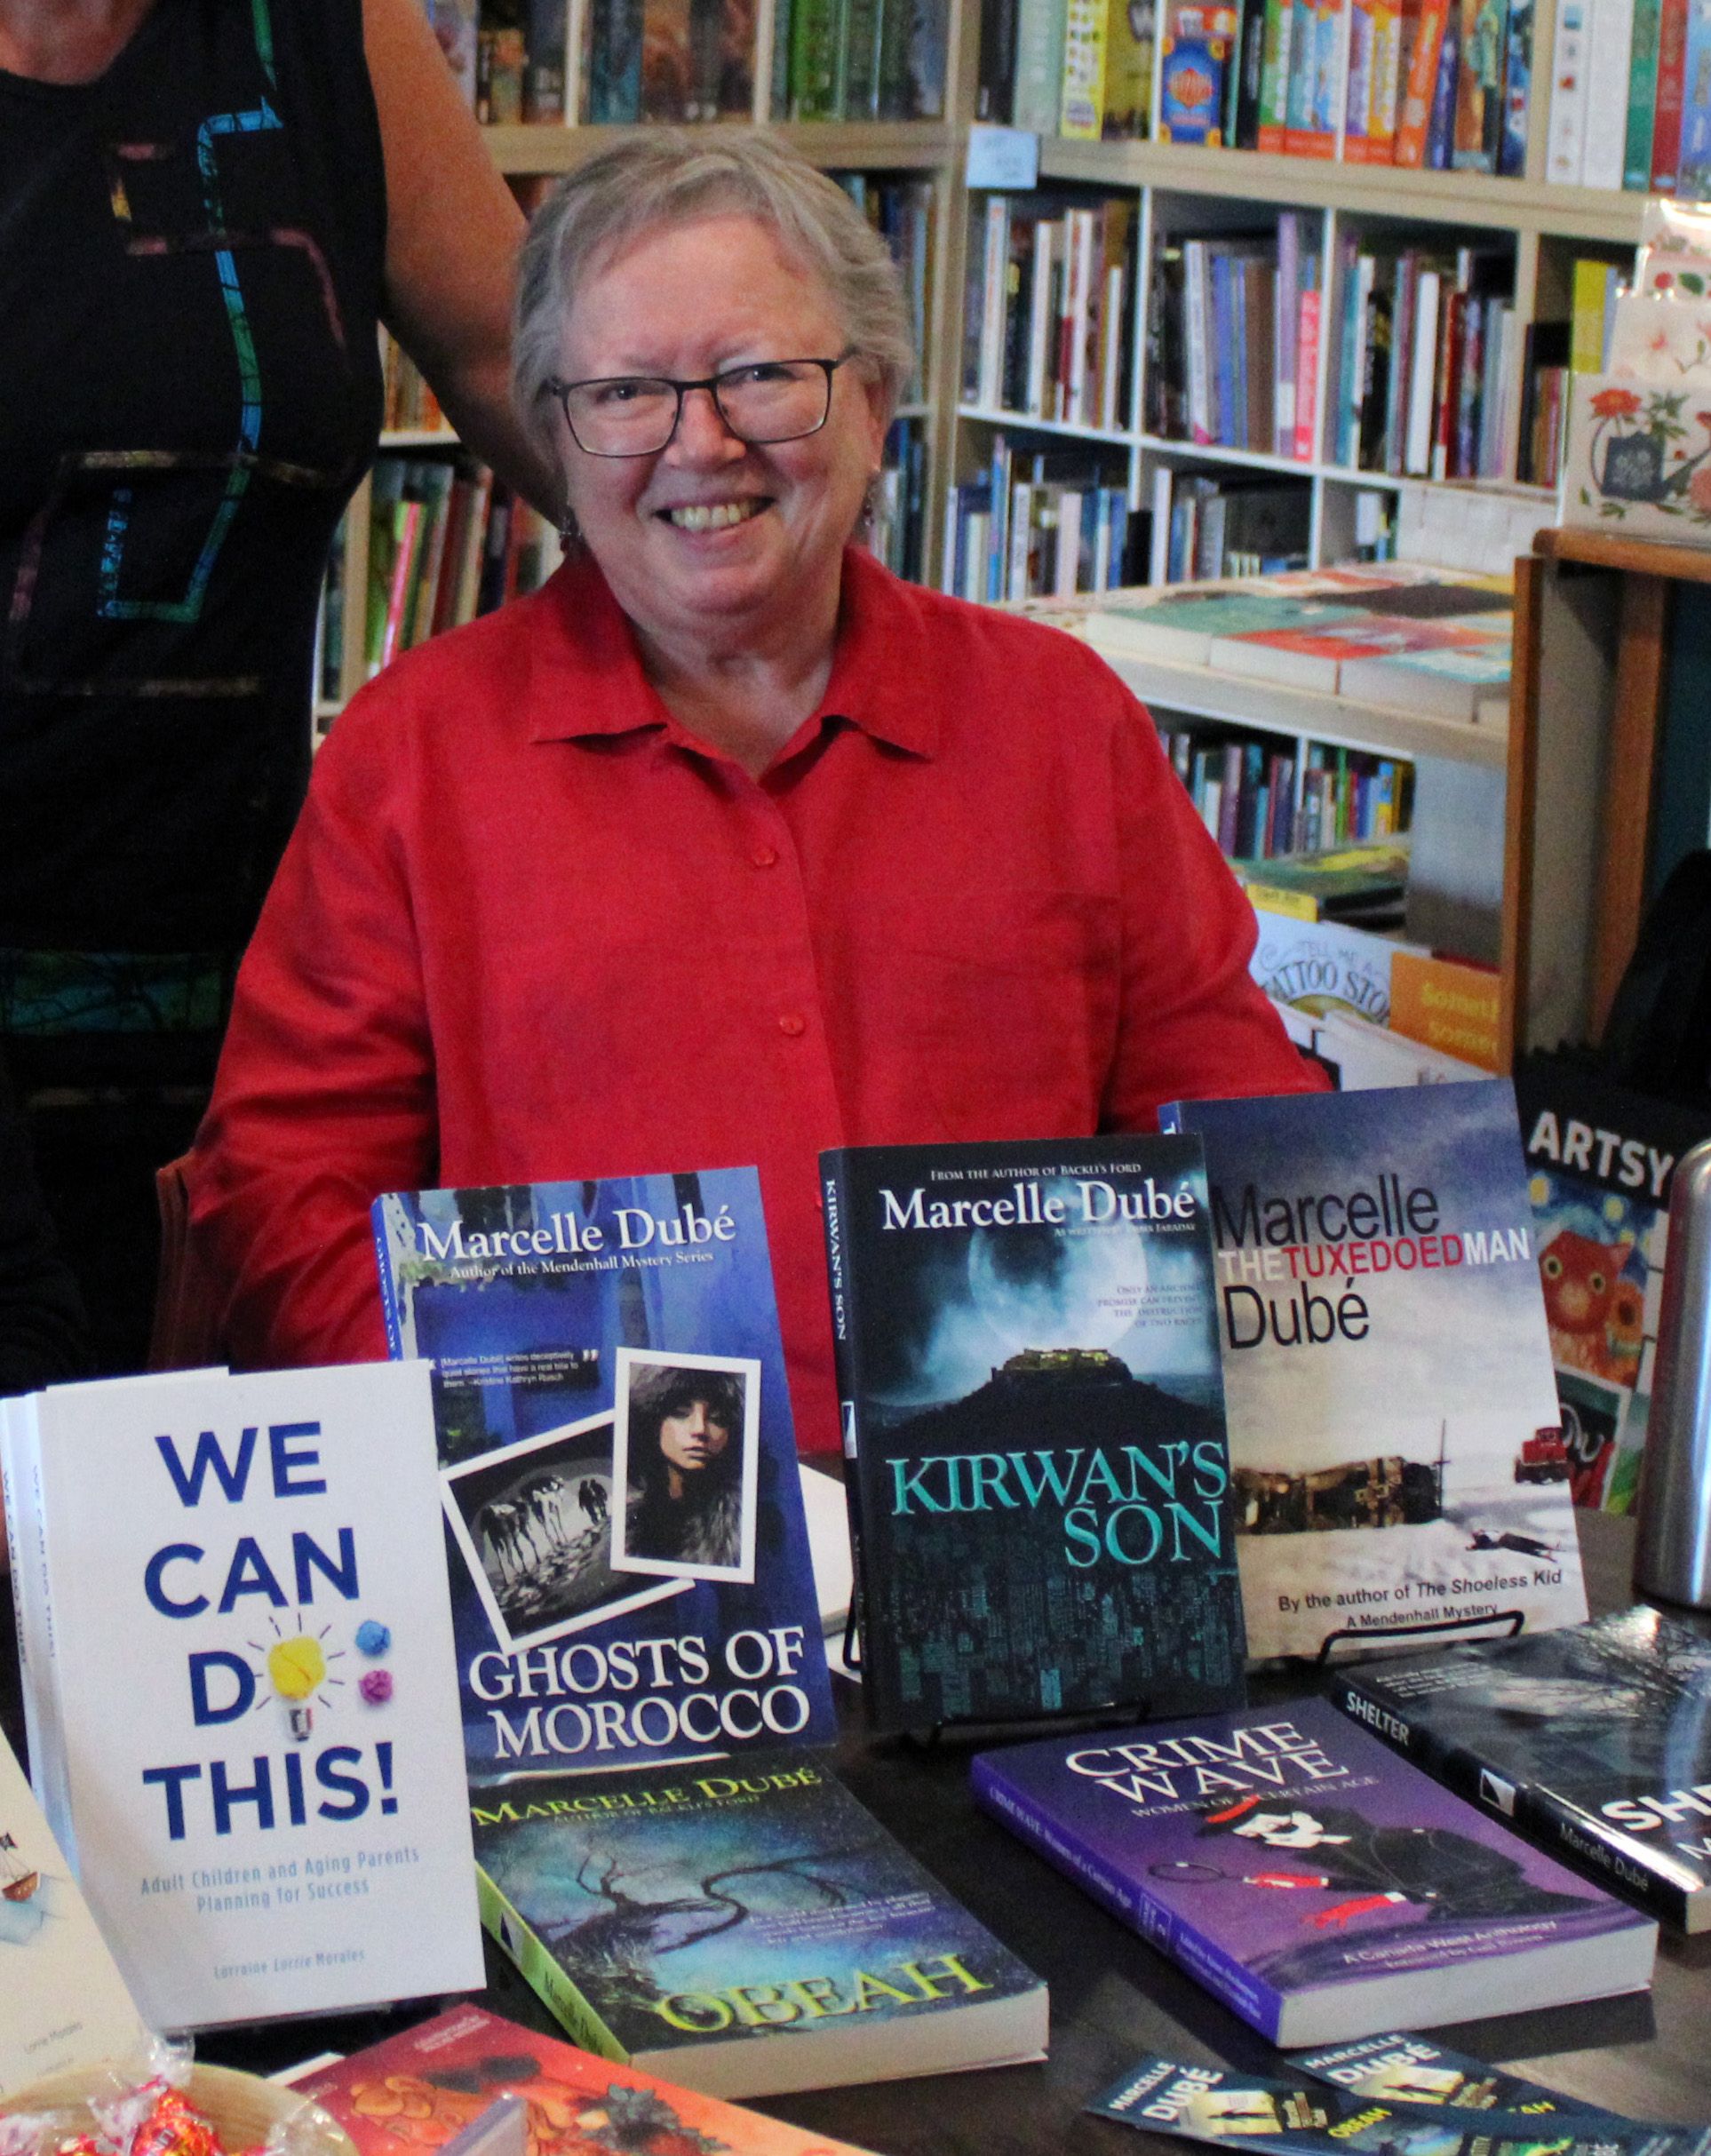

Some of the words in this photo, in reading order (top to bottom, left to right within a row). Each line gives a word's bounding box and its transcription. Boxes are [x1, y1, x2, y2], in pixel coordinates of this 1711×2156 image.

[967, 1168, 990, 1180] THE
[991, 1166, 1040, 1179] AUTHOR
[1527, 1110, 1675, 1197] ARTSY
[417, 1211, 604, 1262] Marcelle
[613, 1203, 736, 1249] Dubé
[879, 1181, 1067, 1230] Marcelle
[1077, 1178, 1196, 1222] Dubé
[1207, 1173, 1440, 1249] Marcelle
[450, 1265, 498, 1280] Author
[499, 1262, 516, 1277] of
[517, 1261, 538, 1276] the
[540, 1255, 619, 1274] Mendenhall
[621, 1253, 673, 1270] Mystery
[675, 1251, 714, 1264] Series
[826, 1179, 843, 1288] KIRWAN'S
[835, 1293, 846, 1340] SON
[1222, 1277, 1369, 1349] Dubé
[156, 1421, 328, 1508] WE
[886, 1441, 1228, 1516] KIRWAN'S
[1063, 1500, 1224, 1568] SON
[144, 1526, 360, 1621] CAN
[1278, 1595, 1300, 1612] By
[1306, 1593, 1332, 1609] the
[1335, 1588, 1389, 1606] author
[1394, 1584, 1411, 1599] of
[1416, 1581, 1446, 1597] The
[1451, 1575, 1528, 1595] Shoeless
[1533, 1569, 1562, 1586] Kid
[1346, 1617, 1357, 1628] A
[1359, 1609, 1440, 1627] Mendenhall
[1444, 1603, 1498, 1619] Mystery
[469, 1635, 710, 1702] GHOSTS
[724, 1626, 805, 1682] OF
[488, 1684, 810, 1760] MOROCCO
[1345, 1691, 1410, 1746] SHELTER
[1065, 1722, 1319, 1778] CRIME
[1094, 1748, 1350, 1804] WAVE
[142, 1741, 399, 1842] THIS!
[470, 1786, 690, 1826] MARCELLE
[695, 1766, 823, 1800] DUBÉ
[140, 1873, 185, 1896] Adult
[192, 1866, 261, 1889] Children
[268, 1860, 298, 1881] and
[305, 1855, 351, 1877] Aging
[358, 1846, 420, 1869] Parents
[1559, 1821, 1612, 1869] Marcelle
[1614, 1856, 1650, 1892] Dubé
[196, 1890, 270, 1914] Planning
[277, 1886, 301, 1905] for
[307, 1879, 370, 1901] Success
[657, 1953, 994, 2033] OBEAH
[1303, 2034, 1406, 2070] MARCELLE
[1325, 2041, 1442, 2085] DUBÉ
[1108, 2061, 1177, 2112] MARCELLE
[1141, 2066, 1224, 2122] DUBÉ
[1326, 2105, 1393, 2140] OBEAH
